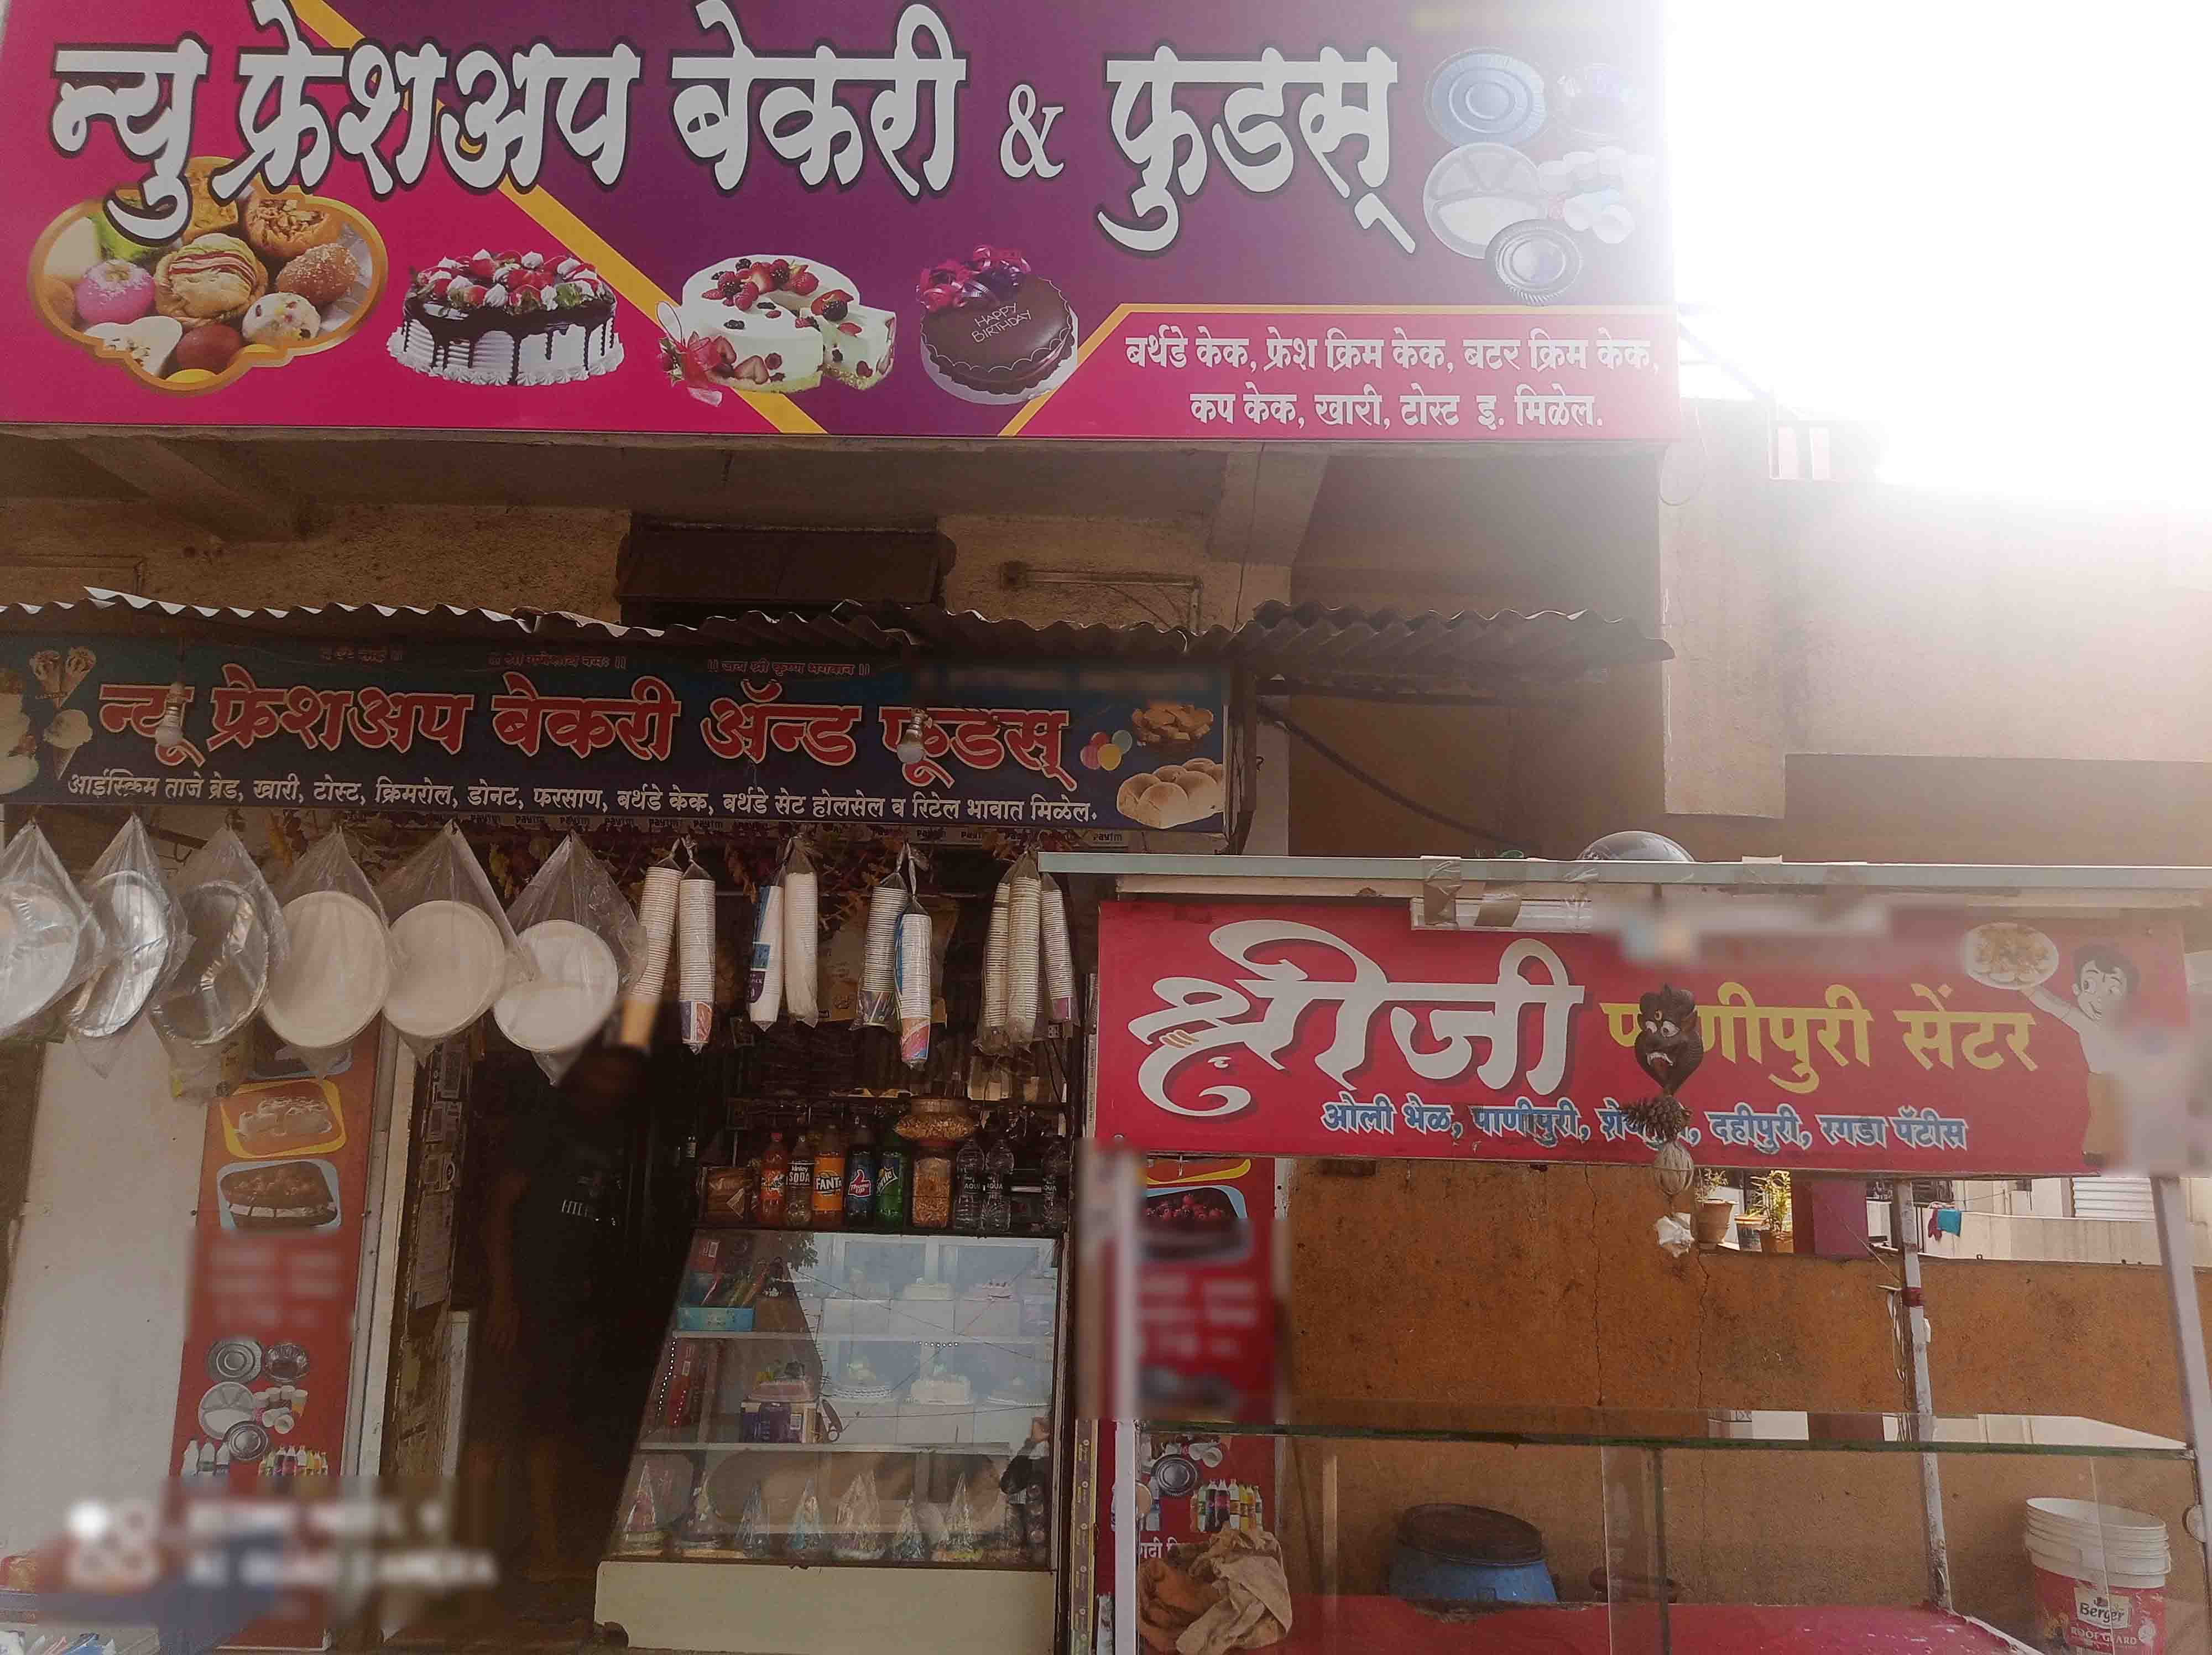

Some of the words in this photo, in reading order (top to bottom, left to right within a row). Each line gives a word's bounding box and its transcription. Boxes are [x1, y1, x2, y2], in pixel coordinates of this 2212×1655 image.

[52, 39, 208, 240] न्यु
[211, 0, 641, 199] फ्रेशअप
[672, 0, 967, 196] बेकरी
[1000, 84, 1065, 179] &
[1097, 45, 1416, 254] फुडस्
[971, 310, 1031, 342] BIRTHDAY
[974, 303, 1018, 327] HAPPY
[1125, 324, 1188, 368] बर्थडे
[1194, 325, 1257, 372] केक,
[1263, 326, 1318, 371] फ्रेश
[1325, 327, 1384, 372] क्रिम
[1391, 326, 1454, 372] केक,
[1462, 339, 1521, 371] बटर
[1528, 327, 1589, 372] क्रिम
[1596, 326, 1660, 372] केक,
[1190, 393, 1236, 424] कप
[1243, 381, 1305, 429] केक,
[1314, 383, 1390, 430] खारी,
[1400, 382, 1460, 425] टोस्ट
[1477, 395, 1505, 430] इ.
[1514, 382, 1603, 426] मिळेल.
[206, 663, 475, 754] फ्रेशअप
[491, 672, 682, 761] बेकरी
[165, 772, 205, 798] ताजे
[252, 773, 304, 804] खारी,
[313, 774, 366, 805] टोस्ट,
[375, 776, 458, 809] क्रिमरोल,
[467, 778, 525, 810] डोनट,
[533, 787, 608, 813] फरसाण,
[616, 783, 664, 811] बर्थडे
[667, 783, 714, 816] केक,
[722, 786, 769, 815] बर्थडे
[774, 787, 807, 815] सेट
[811, 788, 886, 818] होलसेल
[890, 798, 906, 818] व
[911, 790, 962, 820] रिटेल
[966, 799, 1025, 822] भावात
[1030, 793, 1098, 823] मिळेल.
[1128, 919, 1585, 1118] श्रीजी
[1598, 981, 1875, 1095] पणीपुरी
[1893, 983, 2039, 1073] सेंटर
[1319, 1090, 1398, 1135] ओली
[1401, 1092, 1464, 1141] भेळ,
[1468, 1096, 1591, 1148] पाणीपुरी,
[1703, 1101, 1813, 1155] दहीपुरी,
[1814, 1113, 1888, 1150] रगडा
[1888, 1105, 1969, 1151] पॅटीस
[789, 1172, 810, 1183] SODA
[2079, 1602, 2125, 1623] Berger
